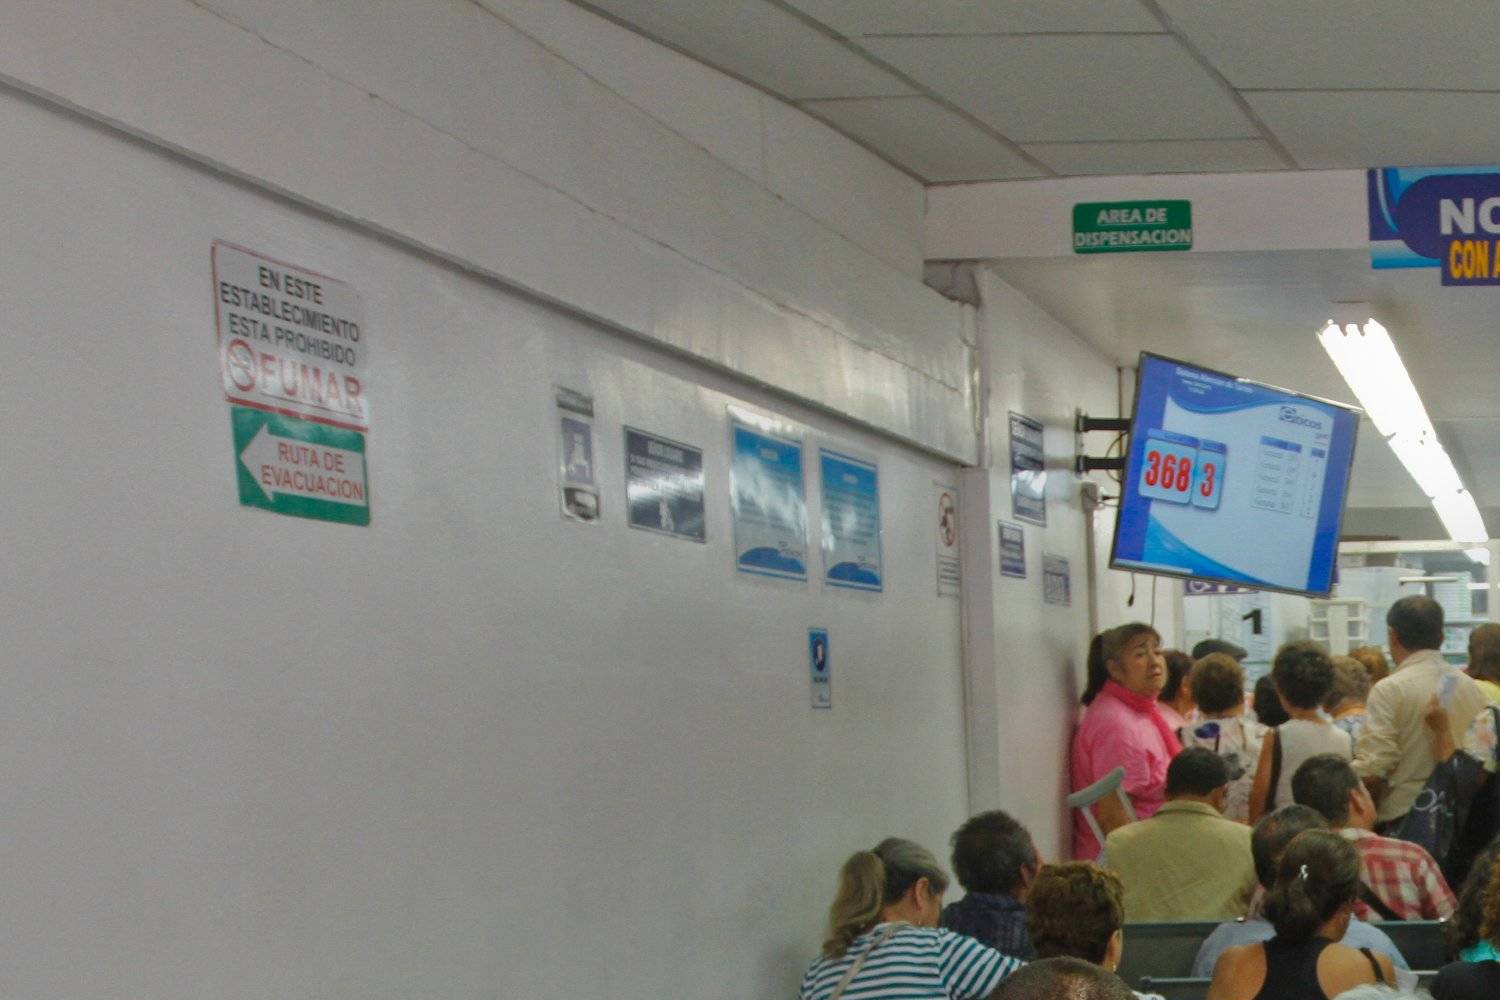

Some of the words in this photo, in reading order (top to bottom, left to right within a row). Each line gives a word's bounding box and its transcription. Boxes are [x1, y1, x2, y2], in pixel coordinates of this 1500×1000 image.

[1097, 208, 1141, 223] AREA
[1145, 207, 1168, 222] DE
[1074, 229, 1192, 246] DISPENSACION
[1450, 239, 1489, 279] CON
[258, 266, 280, 291] EN
[285, 275, 323, 305] ESTE
[220, 281, 360, 342] ESTABLECIMIENTO
[228, 312, 271, 343] ESTA
[274, 325, 357, 367] PROHIBIDO
[260, 353, 363, 412] FUMAR
[278, 441, 319, 468] RUTA
[323, 451, 345, 474] DE
[1144, 450, 1191, 492] 368
[1200, 463, 1215, 497] 3
[261, 464, 363, 501] EVACUACION
[1242, 608, 1262, 635] 1
